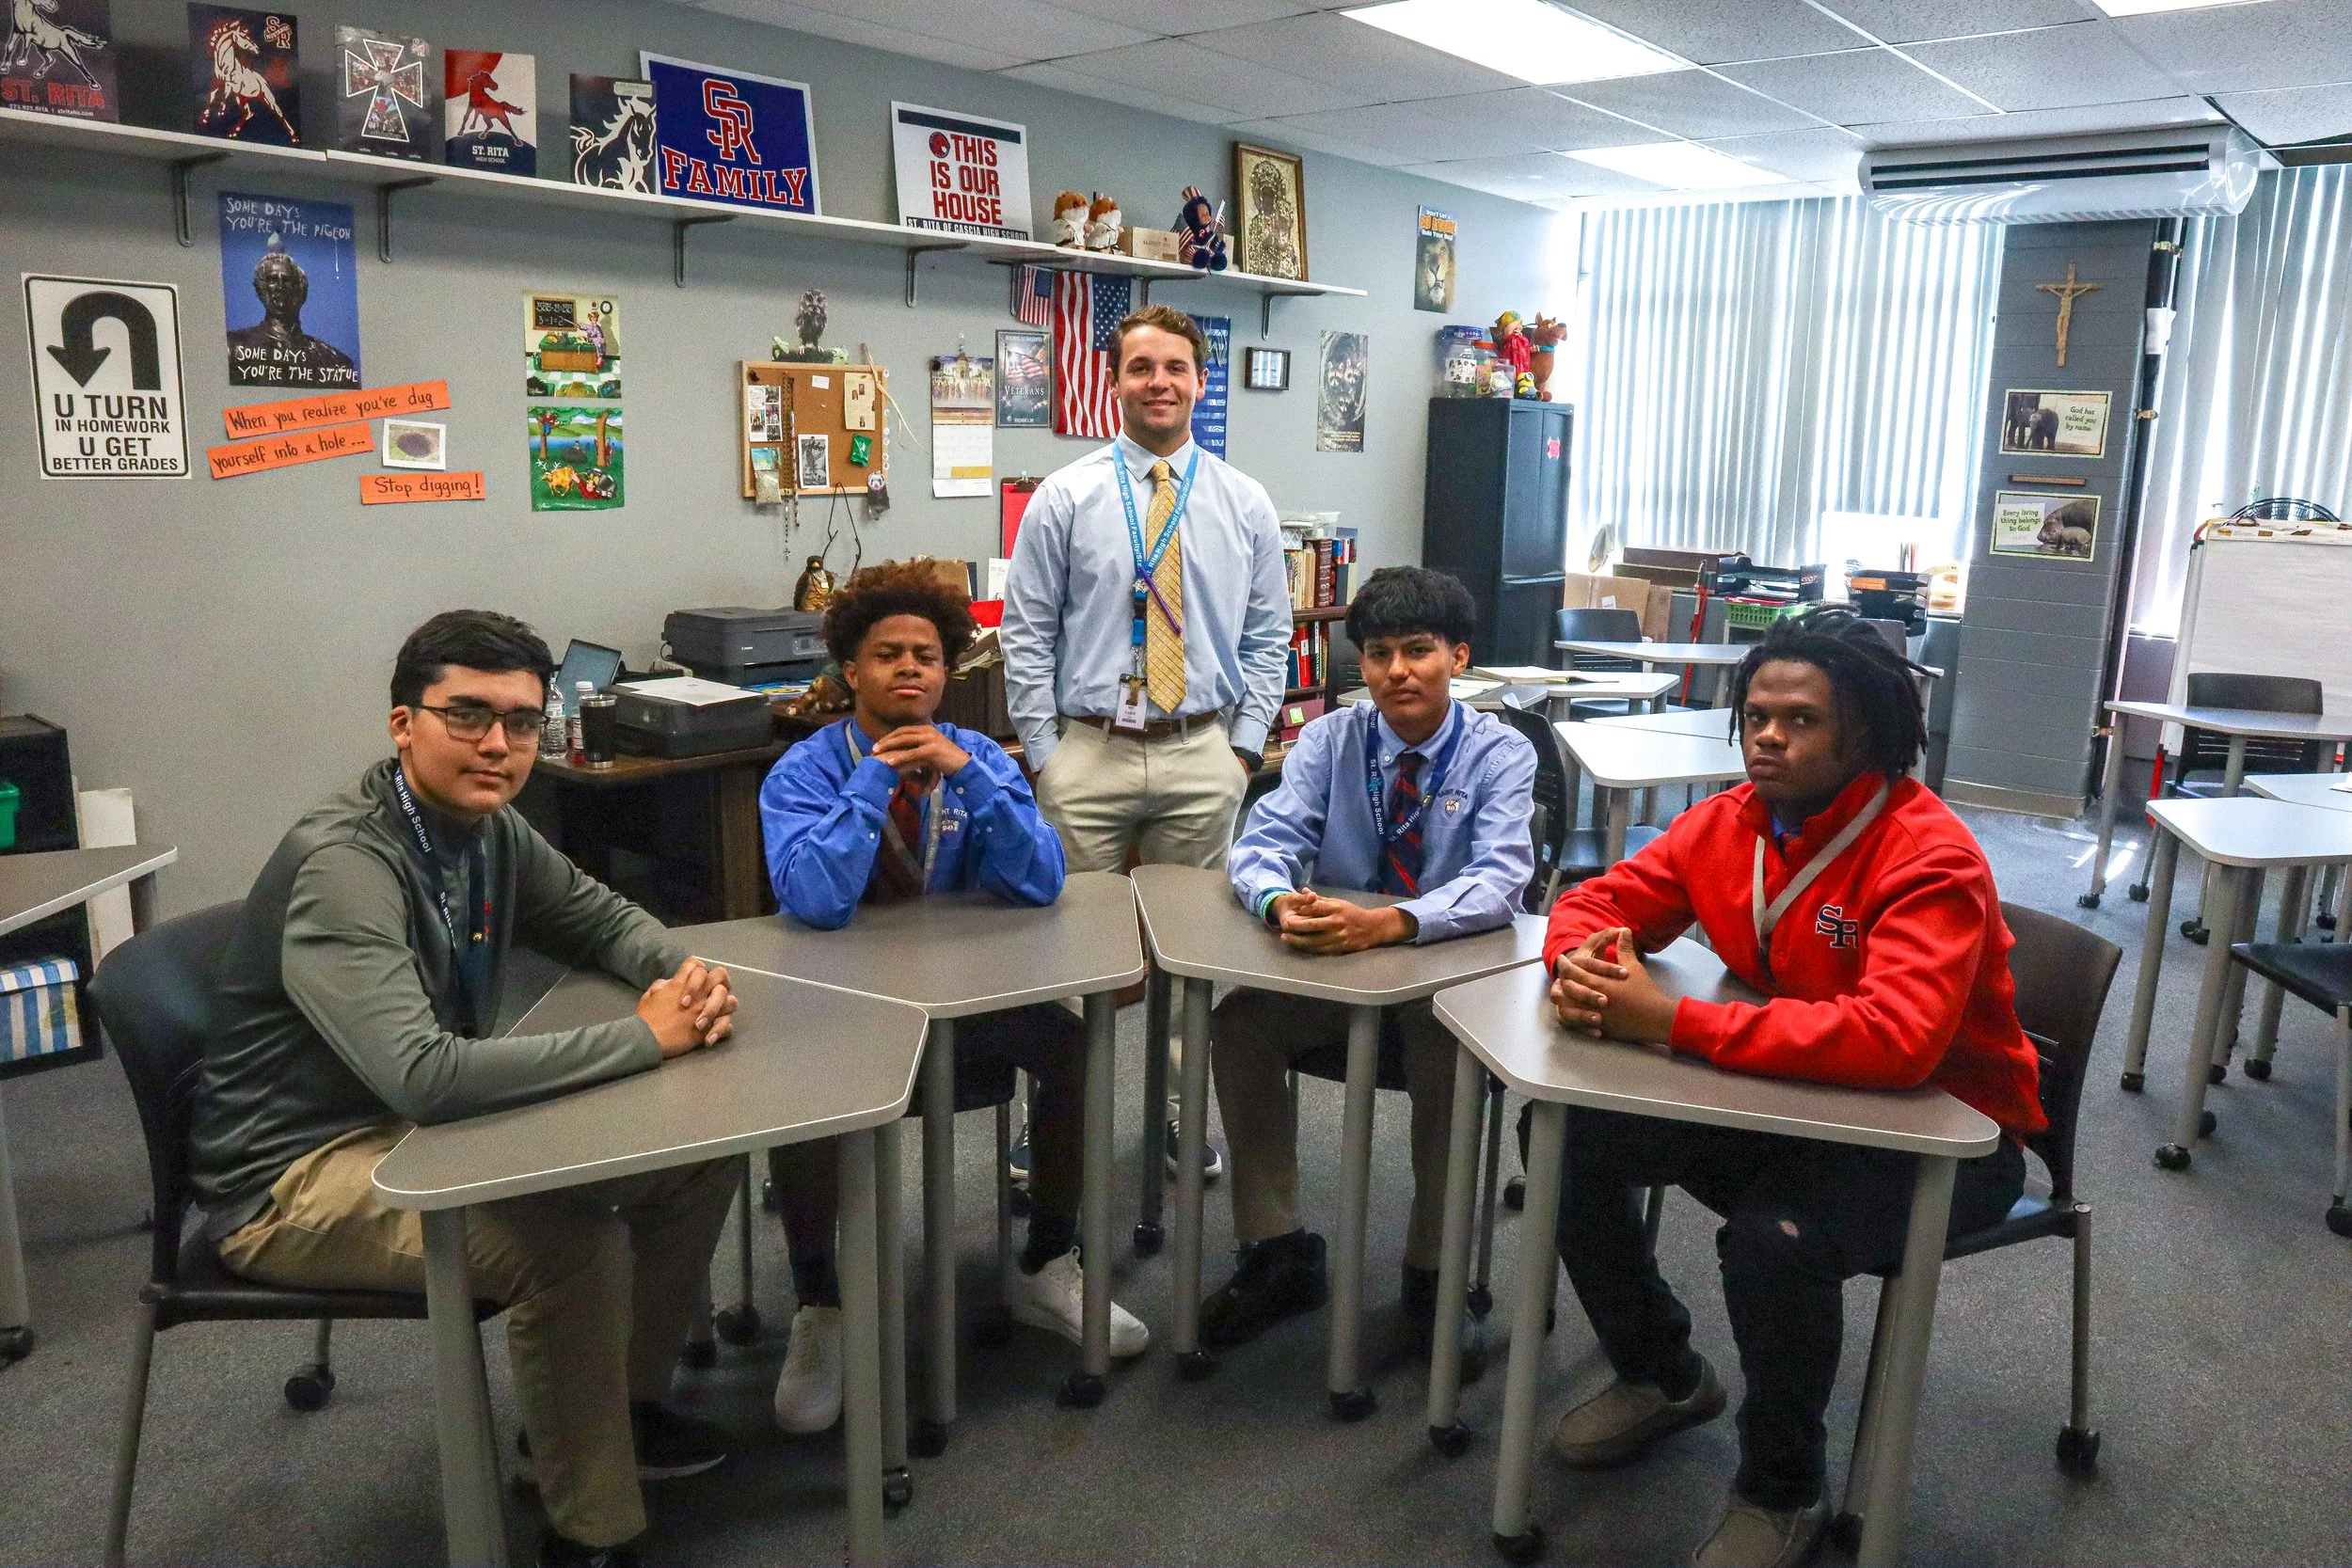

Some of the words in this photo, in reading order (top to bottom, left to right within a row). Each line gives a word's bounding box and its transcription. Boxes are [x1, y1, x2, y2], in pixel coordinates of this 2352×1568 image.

[2, 78, 39, 103] ST.
[48, 83, 105, 108] RITA
[472, 145, 485, 155] ST.
[488, 147, 509, 158] RITA
[950, 134, 997, 167] THIS
[661, 145, 806, 206] FAMILY
[930, 161, 950, 189] IS
[960, 166, 1000, 197] OUR
[227, 198, 257, 214] SOME
[265, 203, 300, 218] DAYS
[933, 191, 1003, 226] HOUSE
[226, 216, 272, 233] YOU'RE
[282, 220, 307, 235] THE
[314, 224, 350, 239] PIGEON
[923, 220, 941, 231] RITA
[943, 223, 952, 232] OF
[954, 224, 980, 235] CASCIA
[982, 228, 999, 238] HIGH
[1001, 230, 1027, 241] SCHOOL
[237, 345, 266, 361] SOME
[274, 349, 307, 363] DAYS
[238, 365, 282, 380] YOU'RE
[289, 367, 312, 380] THE
[319, 368, 358, 382] STATUE
[1005, 386, 1044, 395] VETERANS
[55, 394, 73, 418] U
[84, 395, 167, 420] TURN
[230, 411, 266, 431] When
[273, 412, 296, 429] you
[303, 404, 346, 420] realize
[356, 396, 397, 416] you've
[408, 388, 433, 408] dug
[56, 420, 71, 432] IN
[78, 420, 170, 433] HOMEWORK
[2066, 422, 2074, 431] by
[79, 436, 94, 456] U
[105, 437, 151, 456] GET
[213, 446, 265, 470] yourself
[275, 441, 298, 459] into
[306, 444, 315, 453] a
[318, 434, 345, 451] hole
[53, 458, 111, 470] BETTER
[118, 458, 178, 470] GRADES
[374, 476, 412, 497] Stop
[420, 474, 480, 498] digging!
[1126, 501, 1136, 525] School
[1131, 527, 1142, 571] Faculty/Sta
[1148, 554, 1159, 567] Rita
[1155, 538, 1167, 554] High
[1164, 515, 1178, 538] School
[1455, 790, 1468, 800] RITA
[394, 774, 404, 792] Rita
[399, 790, 415, 816] High
[411, 816, 432, 853] School
[954, 809, 968, 818] RITA
[1375, 807, 1384, 834] School
[1396, 822, 1409, 835] Rita
[1816, 904, 1859, 949] SR
